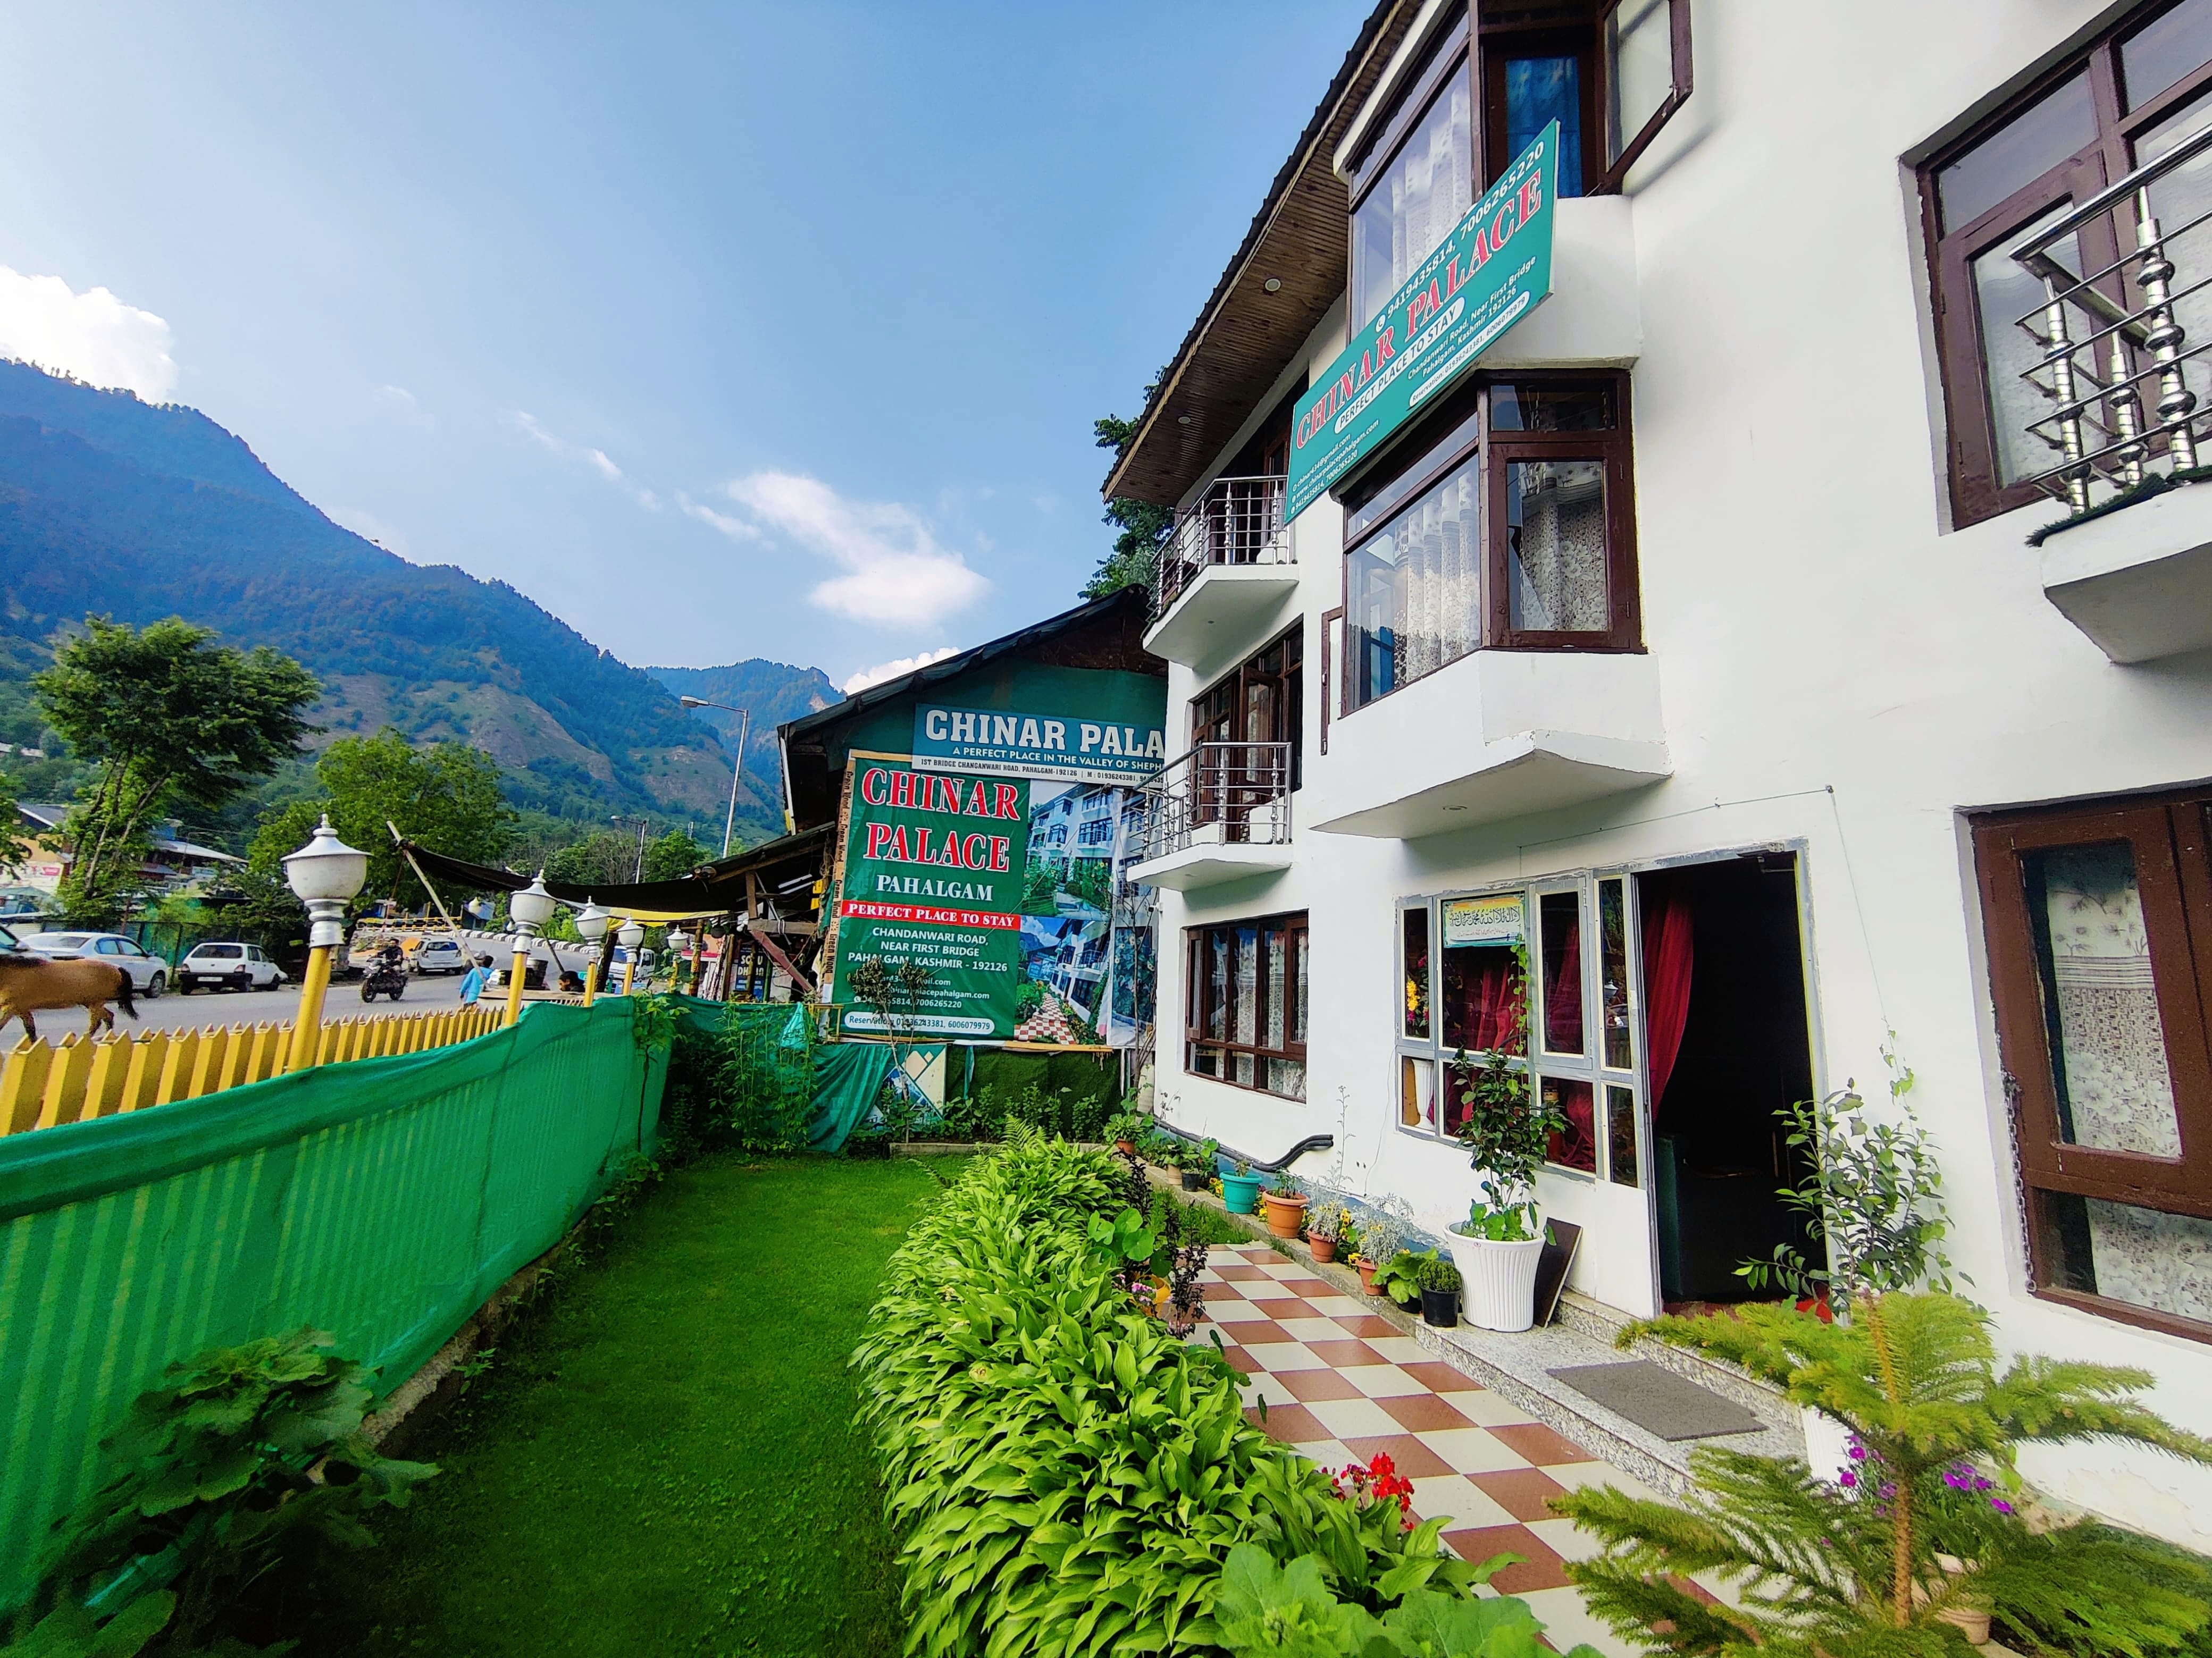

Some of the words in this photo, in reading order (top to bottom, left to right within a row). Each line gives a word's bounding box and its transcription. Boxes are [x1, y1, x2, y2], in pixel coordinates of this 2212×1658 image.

[1387, 239, 1456, 319] 9419435814,
[1460, 141, 1544, 240] 7006265220
[1296, 325, 1396, 449] CHINAR
[1404, 167, 1542, 343] PALACE
[1408, 336, 1448, 380] Chandanwari
[1449, 318, 1469, 342] Road,
[1471, 299, 1489, 322] Near
[1490, 283, 1507, 304] First
[1509, 256, 1536, 283] Bridge
[1422, 344, 1456, 378] Pahalgam,
[1457, 314, 1487, 346] Kashmir
[1488, 285, 1516, 317] 192126
[1412, 371, 1444, 402] Reservation:
[1486, 296, 1526, 336] 6006079979
[1339, 386, 1376, 428] PERFECT
[1378, 357, 1407, 392] PLACE
[1410, 338, 1425, 359] TO
[1427, 305, 1456, 343] STAY
[1296, 419, 1379, 499] www.chinarpalacepahalgam.com
[1326, 449, 1358, 483] 7006265220
[926, 710, 1066, 751] CHINAR
[963, 747, 1007, 758] PERFECT
[1010, 751, 1041, 761] PLACE
[1044, 753, 1055, 762] IN
[1058, 754, 1077, 764] THE
[1079, 757, 1113, 767] VALLEY
[1116, 759, 1129, 769] OF
[1022, 766, 1077, 776] PAHALGAM-192126
[861, 768, 1020, 821] CHINAR
[839, 824, 848, 843] Green
[863, 822, 1010, 872] PALACE
[833, 879, 843, 898] Green
[876, 874, 994, 902] PAHALGAM
[832, 900, 841, 919] Wood
[848, 903, 912, 919] PERFECT
[916, 909, 958, 922] PLACE
[961, 913, 979, 924] TO
[983, 914, 1015, 928] STAY
[828, 933, 837, 953] Green
[872, 927, 955, 941] CHANDANWARI
[957, 935, 989, 946] ROAD,
[741, 955, 763, 965] SOU
[881, 941, 909, 952] NEAR
[912, 943, 941, 954] FIRST
[942, 946, 980, 957] BRIDGE
[826, 955, 835, 973] Wood
[915, 957, 963, 969] KASHMIR
[973, 961, 1008, 972] 192126
[915, 999, 962, 1008] 7006265220
[948, 1021, 990, 1030] 6006079979
